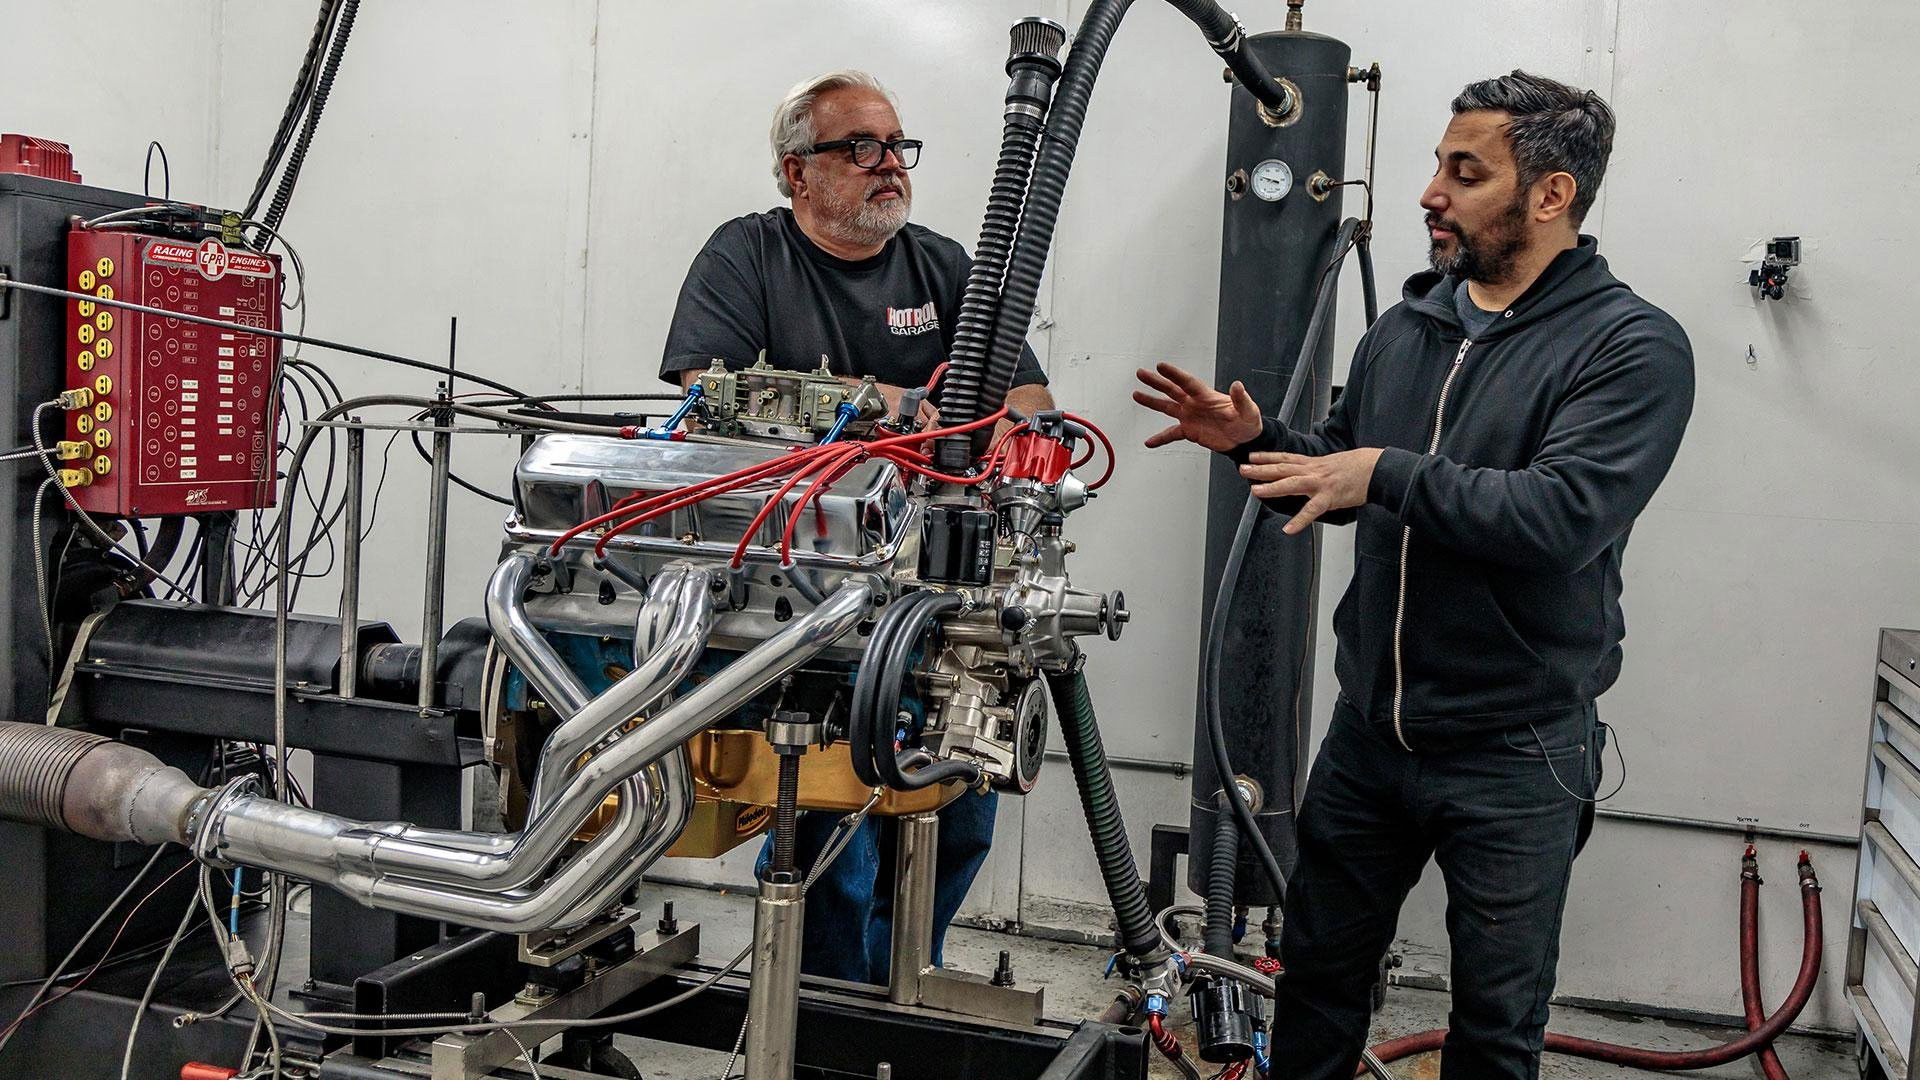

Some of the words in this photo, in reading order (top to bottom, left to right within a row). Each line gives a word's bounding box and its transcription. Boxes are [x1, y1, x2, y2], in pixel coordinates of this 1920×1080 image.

[153, 245, 194, 258] RACING
[201, 250, 225, 266] CPR
[229, 256, 267, 267] ENGINES
[890, 320, 940, 336] GARAGE
